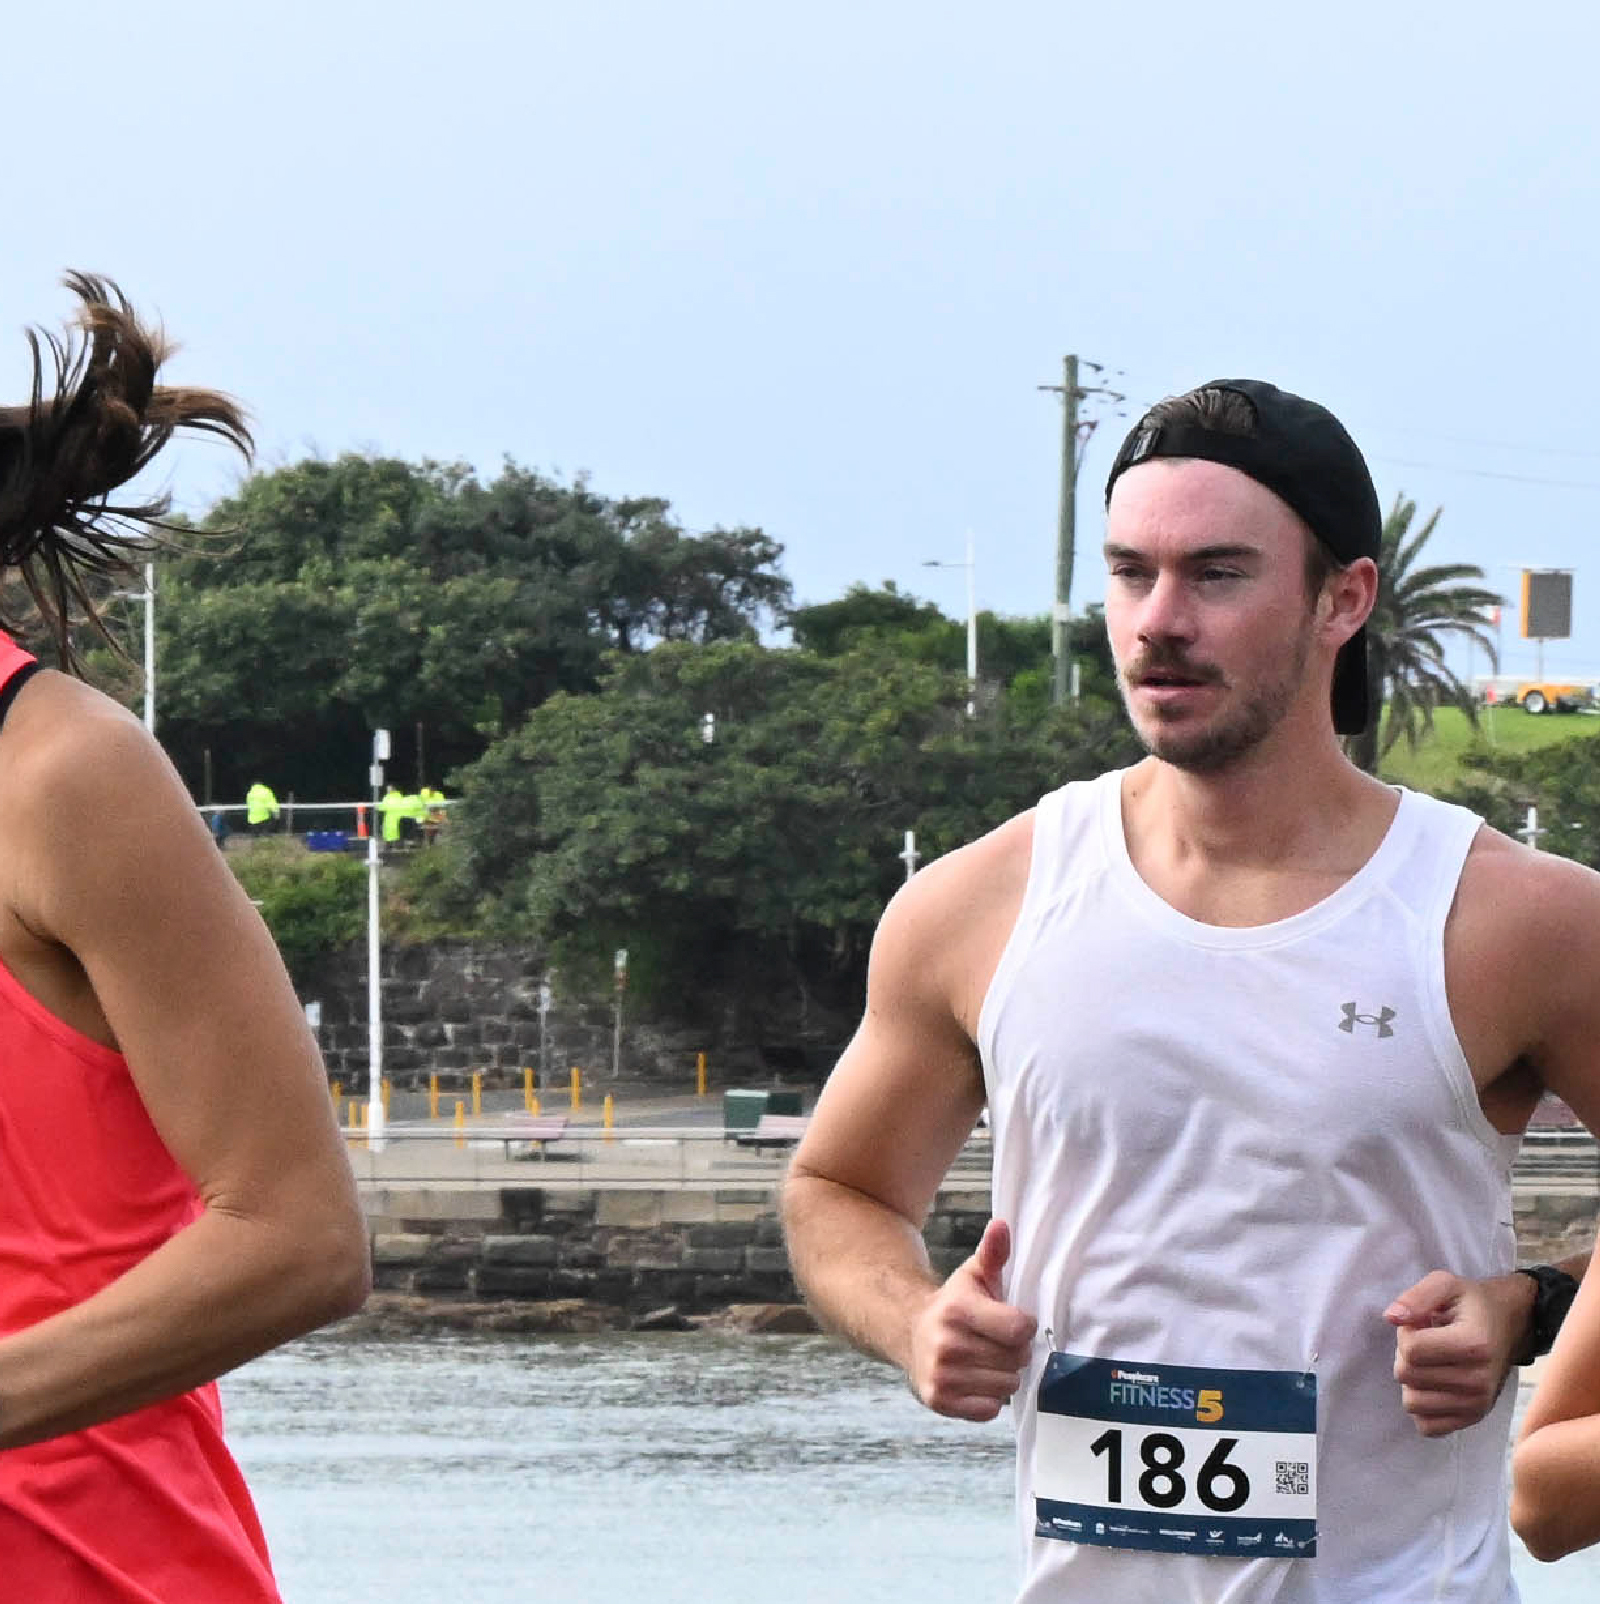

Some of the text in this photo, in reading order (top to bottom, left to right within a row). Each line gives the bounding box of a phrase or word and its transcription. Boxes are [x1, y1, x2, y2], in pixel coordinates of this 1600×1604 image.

[1110, 1382, 1225, 1422] FITNESS 5
[1090, 1429, 1250, 1512] 186
